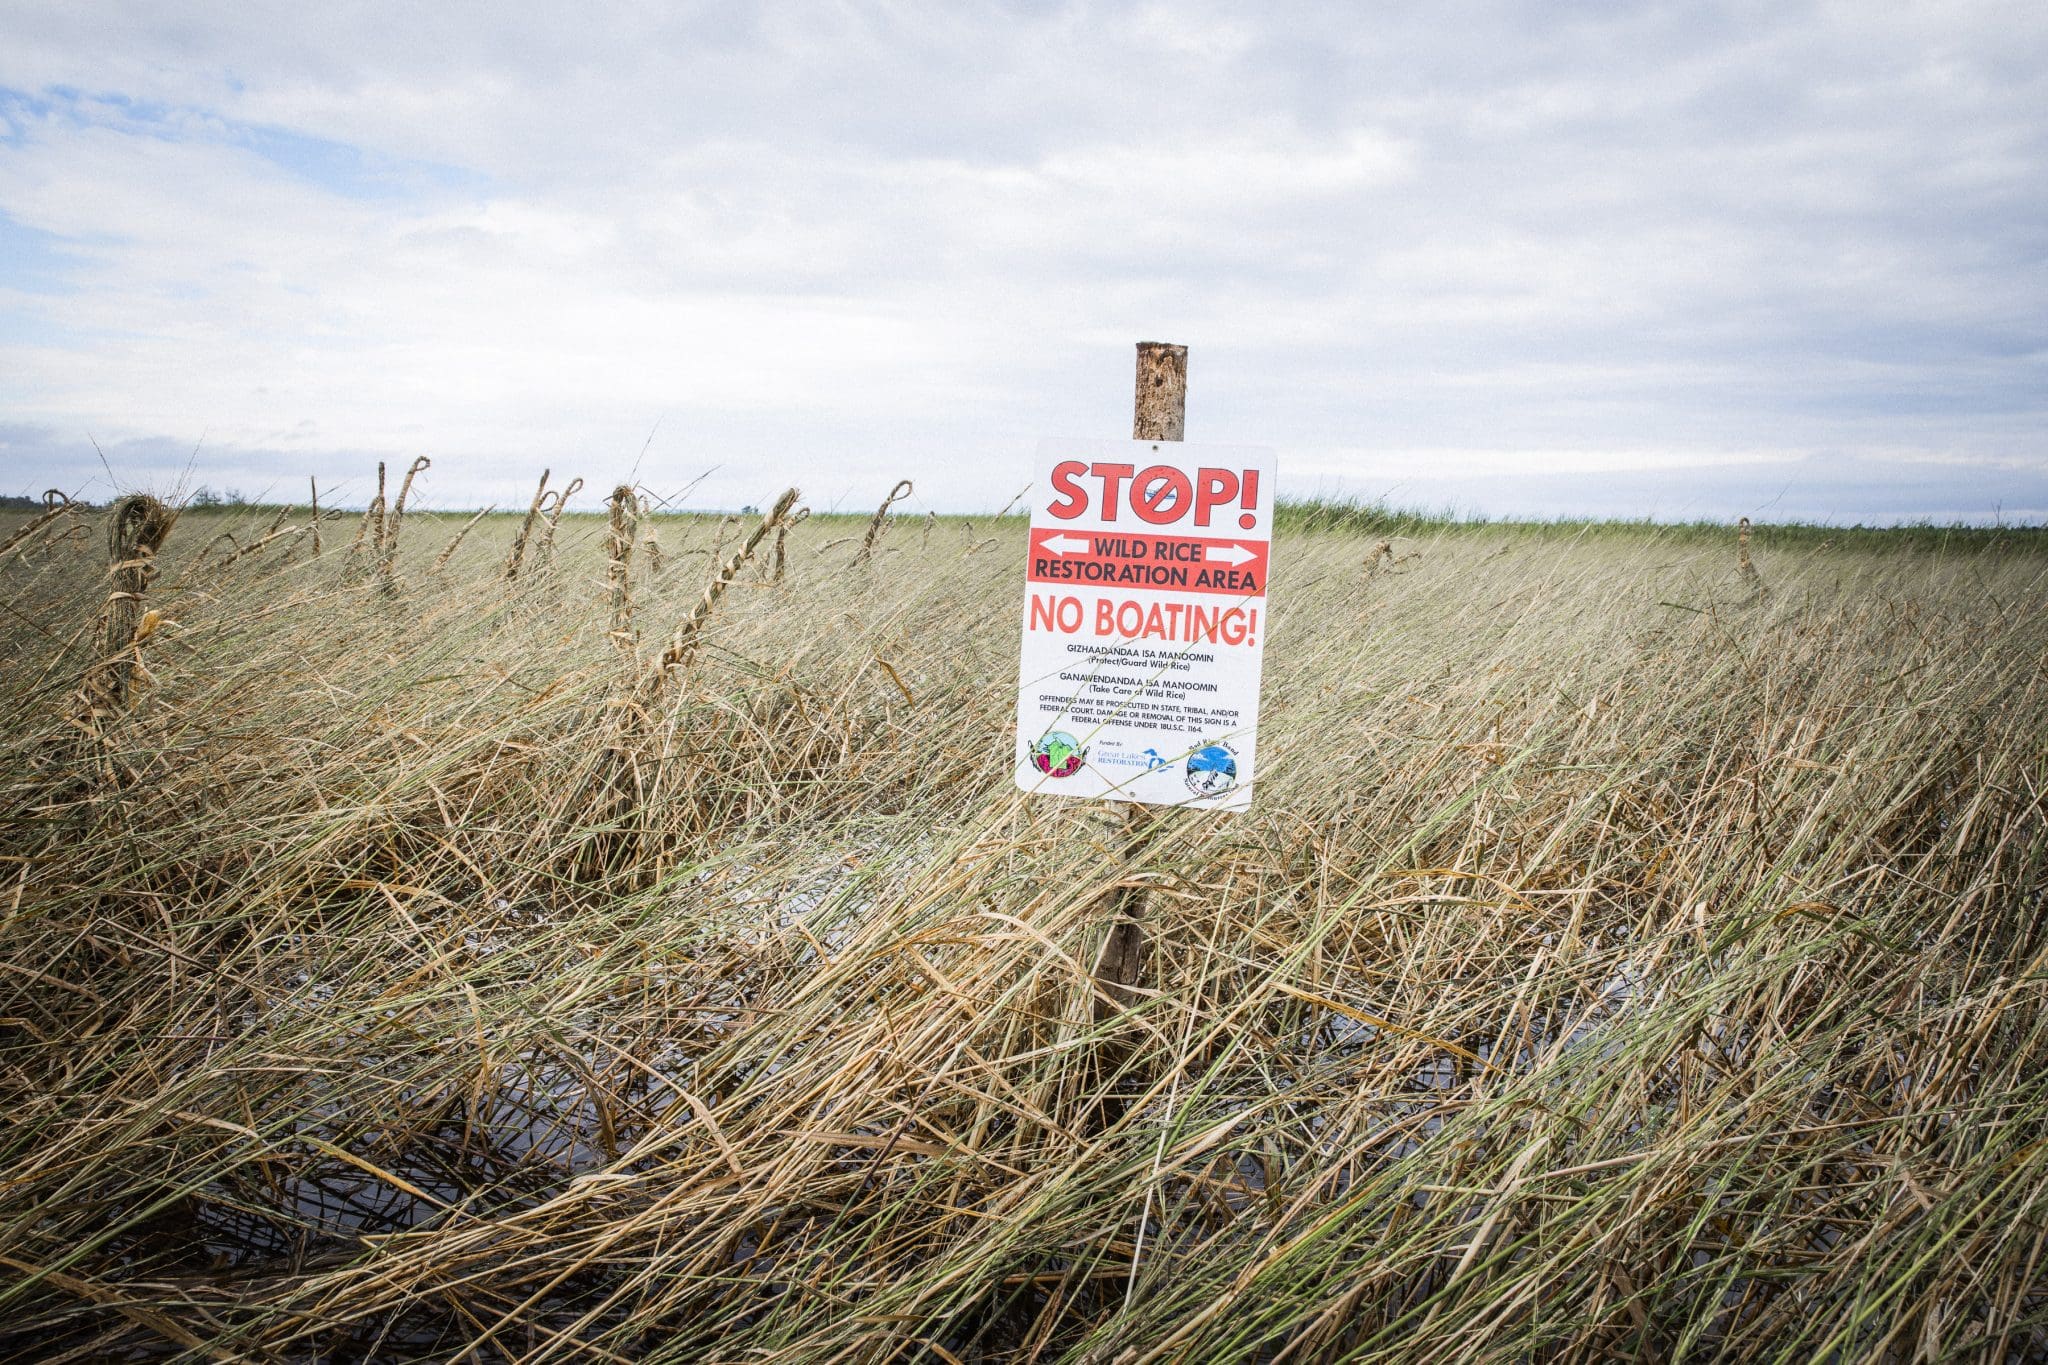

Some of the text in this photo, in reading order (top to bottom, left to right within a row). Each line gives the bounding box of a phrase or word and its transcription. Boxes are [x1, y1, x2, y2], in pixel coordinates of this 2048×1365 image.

[1046, 460, 1260, 530] STOP!
[1094, 537, 1202, 562] WILD RICE
[1035, 558, 1257, 591] RESTORATION AREA
[1030, 594, 1257, 647] NO BOATING!
[1067, 644, 1214, 662] GIZHAADANDAA ISA MANOOMIN
[1088, 656, 1190, 672] (Protect/Guard Wild Rice)
[1059, 672, 1218, 692] GANAWENDANDAA ISA MANOOMIN
[1089, 684, 1110, 694] (Take
[1112, 686, 1132, 695] Care
[1145, 689, 1163, 698] Wild
[1166, 690, 1186, 700] Rice)
[1040, 704, 1069, 713] FEDERAL
[1129, 711, 1140, 719] OR
[1142, 712, 1174, 722] REMOVAL
[1188, 716, 1202, 725] THIS
[1204, 717, 1221, 726] SIGN
[1079, 698, 1094, 706] MAY
[1151, 703, 1159, 711] IN
[1210, 709, 1239, 718] AND/OR
[1072, 715, 1101, 724] FEDERAL
[1134, 720, 1158, 729] UNDER
[1097, 757, 1149, 767] RESTORATION
